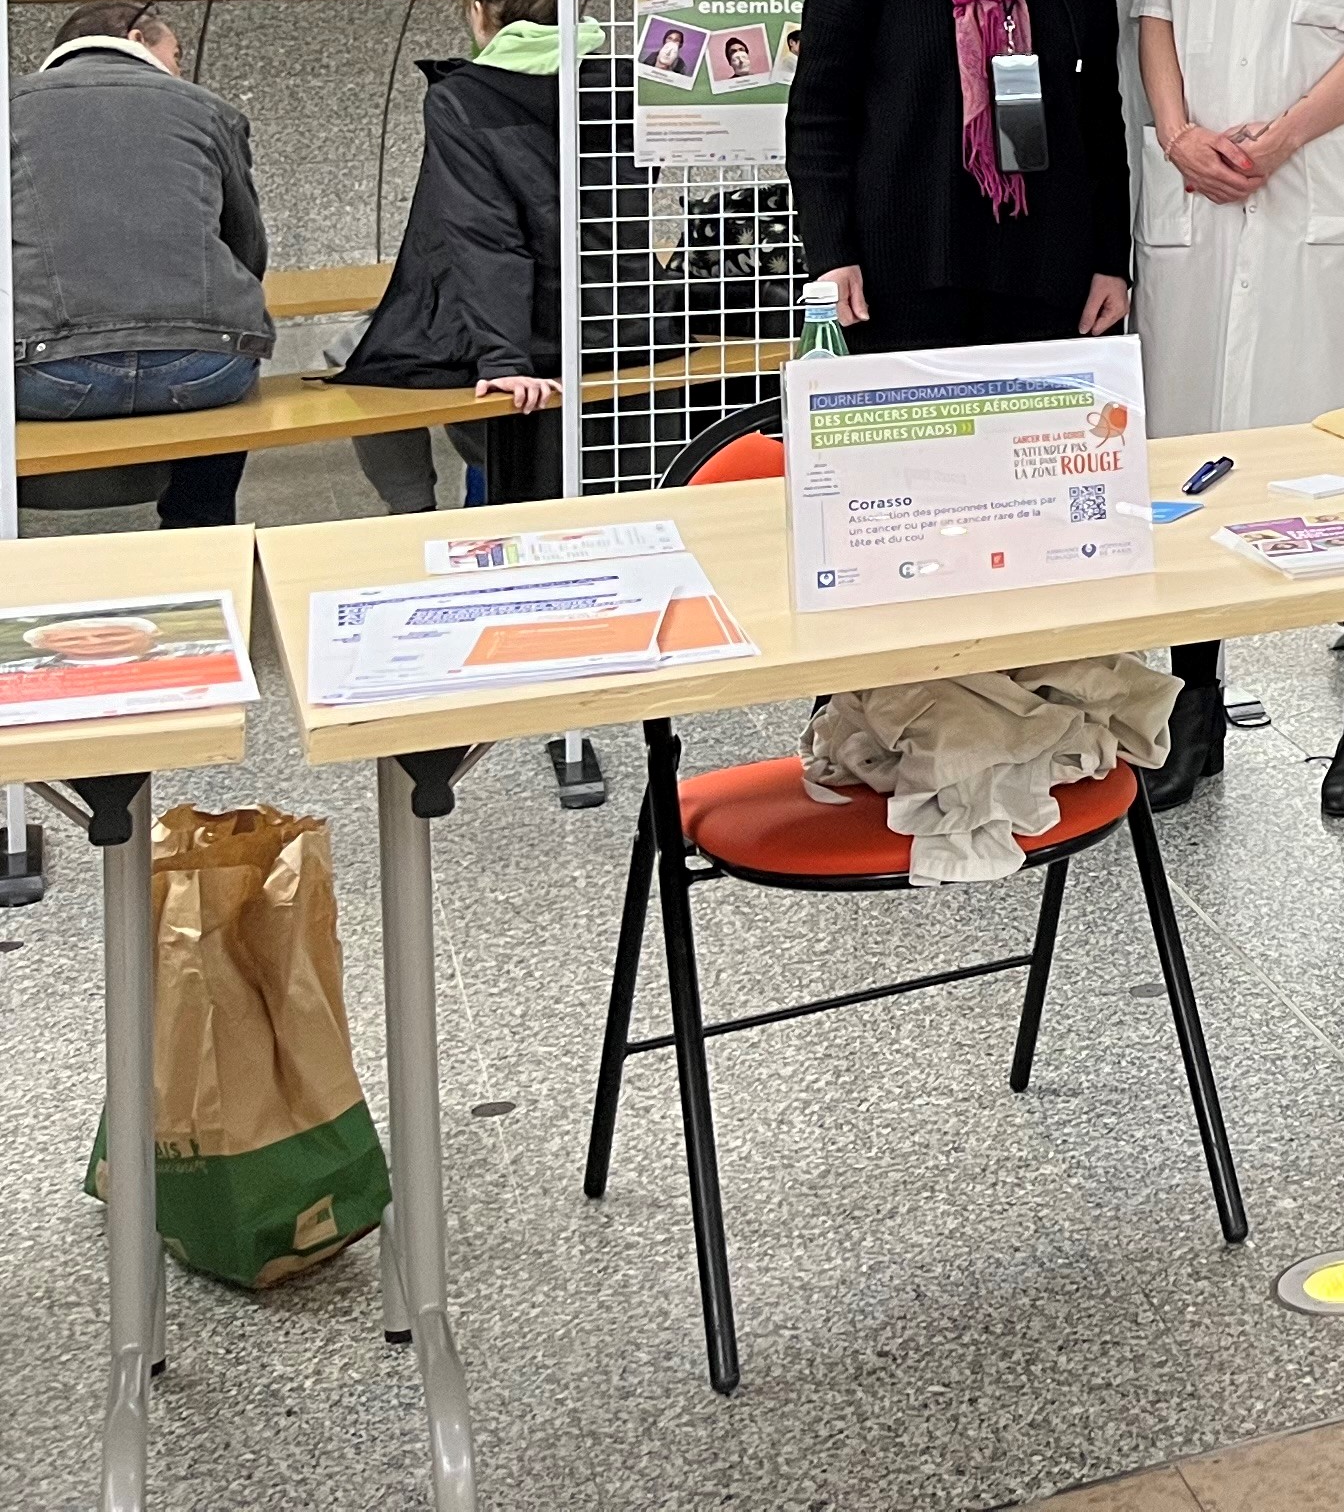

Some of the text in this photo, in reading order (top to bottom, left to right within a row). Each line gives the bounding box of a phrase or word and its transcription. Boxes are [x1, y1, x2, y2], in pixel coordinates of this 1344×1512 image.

[875, 382, 986, 405] D'INFORMATIONS
[988, 381, 1002, 393] ET
[1006, 379, 1023, 392] DE
[814, 392, 1093, 427] DES CANCERS DES VOIES AÉRODIGESTIVES
[814, 423, 958, 448] SUPÉRIEURES (VADS)
[1014, 467, 1029, 480] LA
[1060, 450, 1124, 476] ROUGE
[848, 495, 913, 512] Corasso
[849, 495, 1057, 524] Assotion des personnes touchées par
[849, 526, 863, 536] un
[865, 523, 901, 535] cancer
[904, 521, 918, 530] ou
[921, 519, 938, 532] par
[956, 515, 992, 526] cancer
[993, 511, 1014, 522] rare
[1016, 509, 1030, 519] de
[1031, 508, 1041, 518] la
[874, 536, 886, 546] et
[888, 534, 903, 545] du
[904, 534, 925, 543] cou
